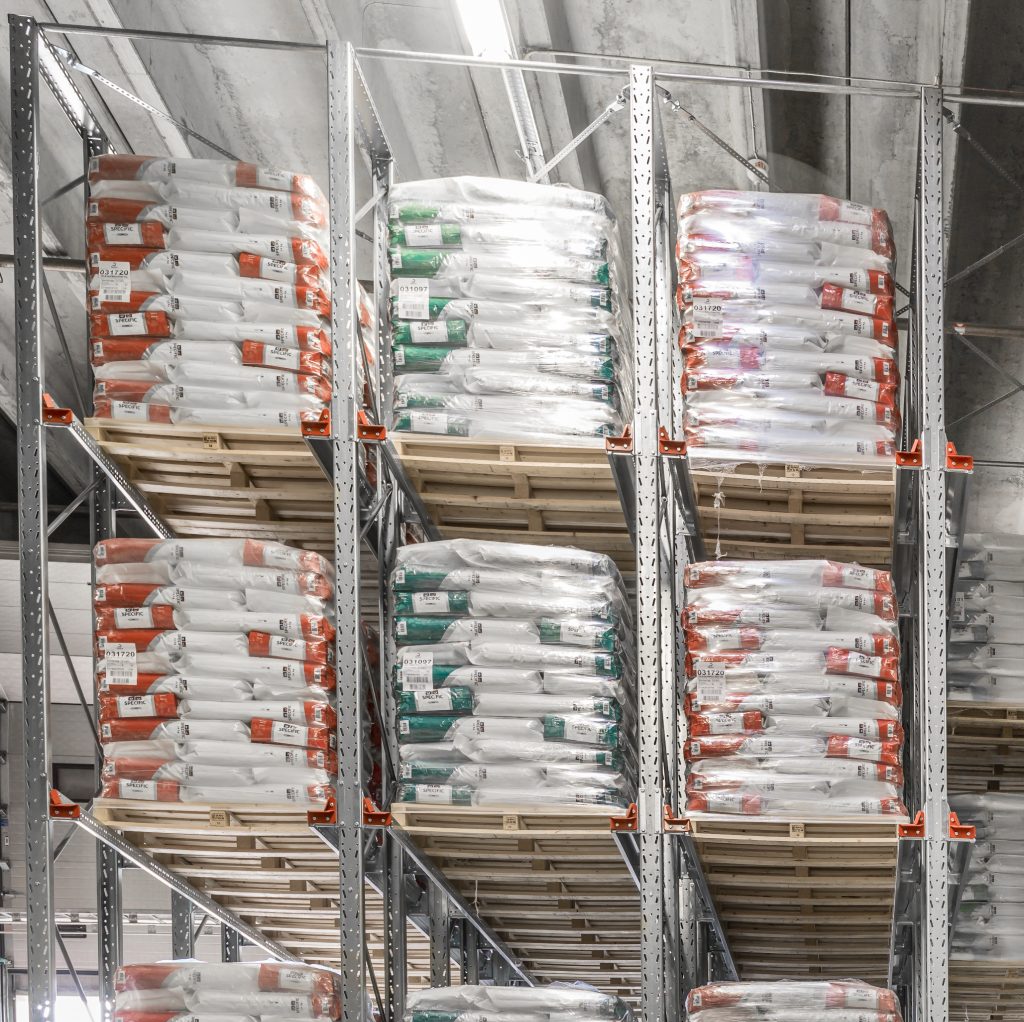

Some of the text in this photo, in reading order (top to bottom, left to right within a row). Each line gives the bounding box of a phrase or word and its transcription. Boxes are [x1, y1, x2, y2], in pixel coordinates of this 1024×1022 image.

[105, 651, 136, 659] 031720
[403, 658, 432, 666] 031097
[697, 669, 725, 677] 031720
